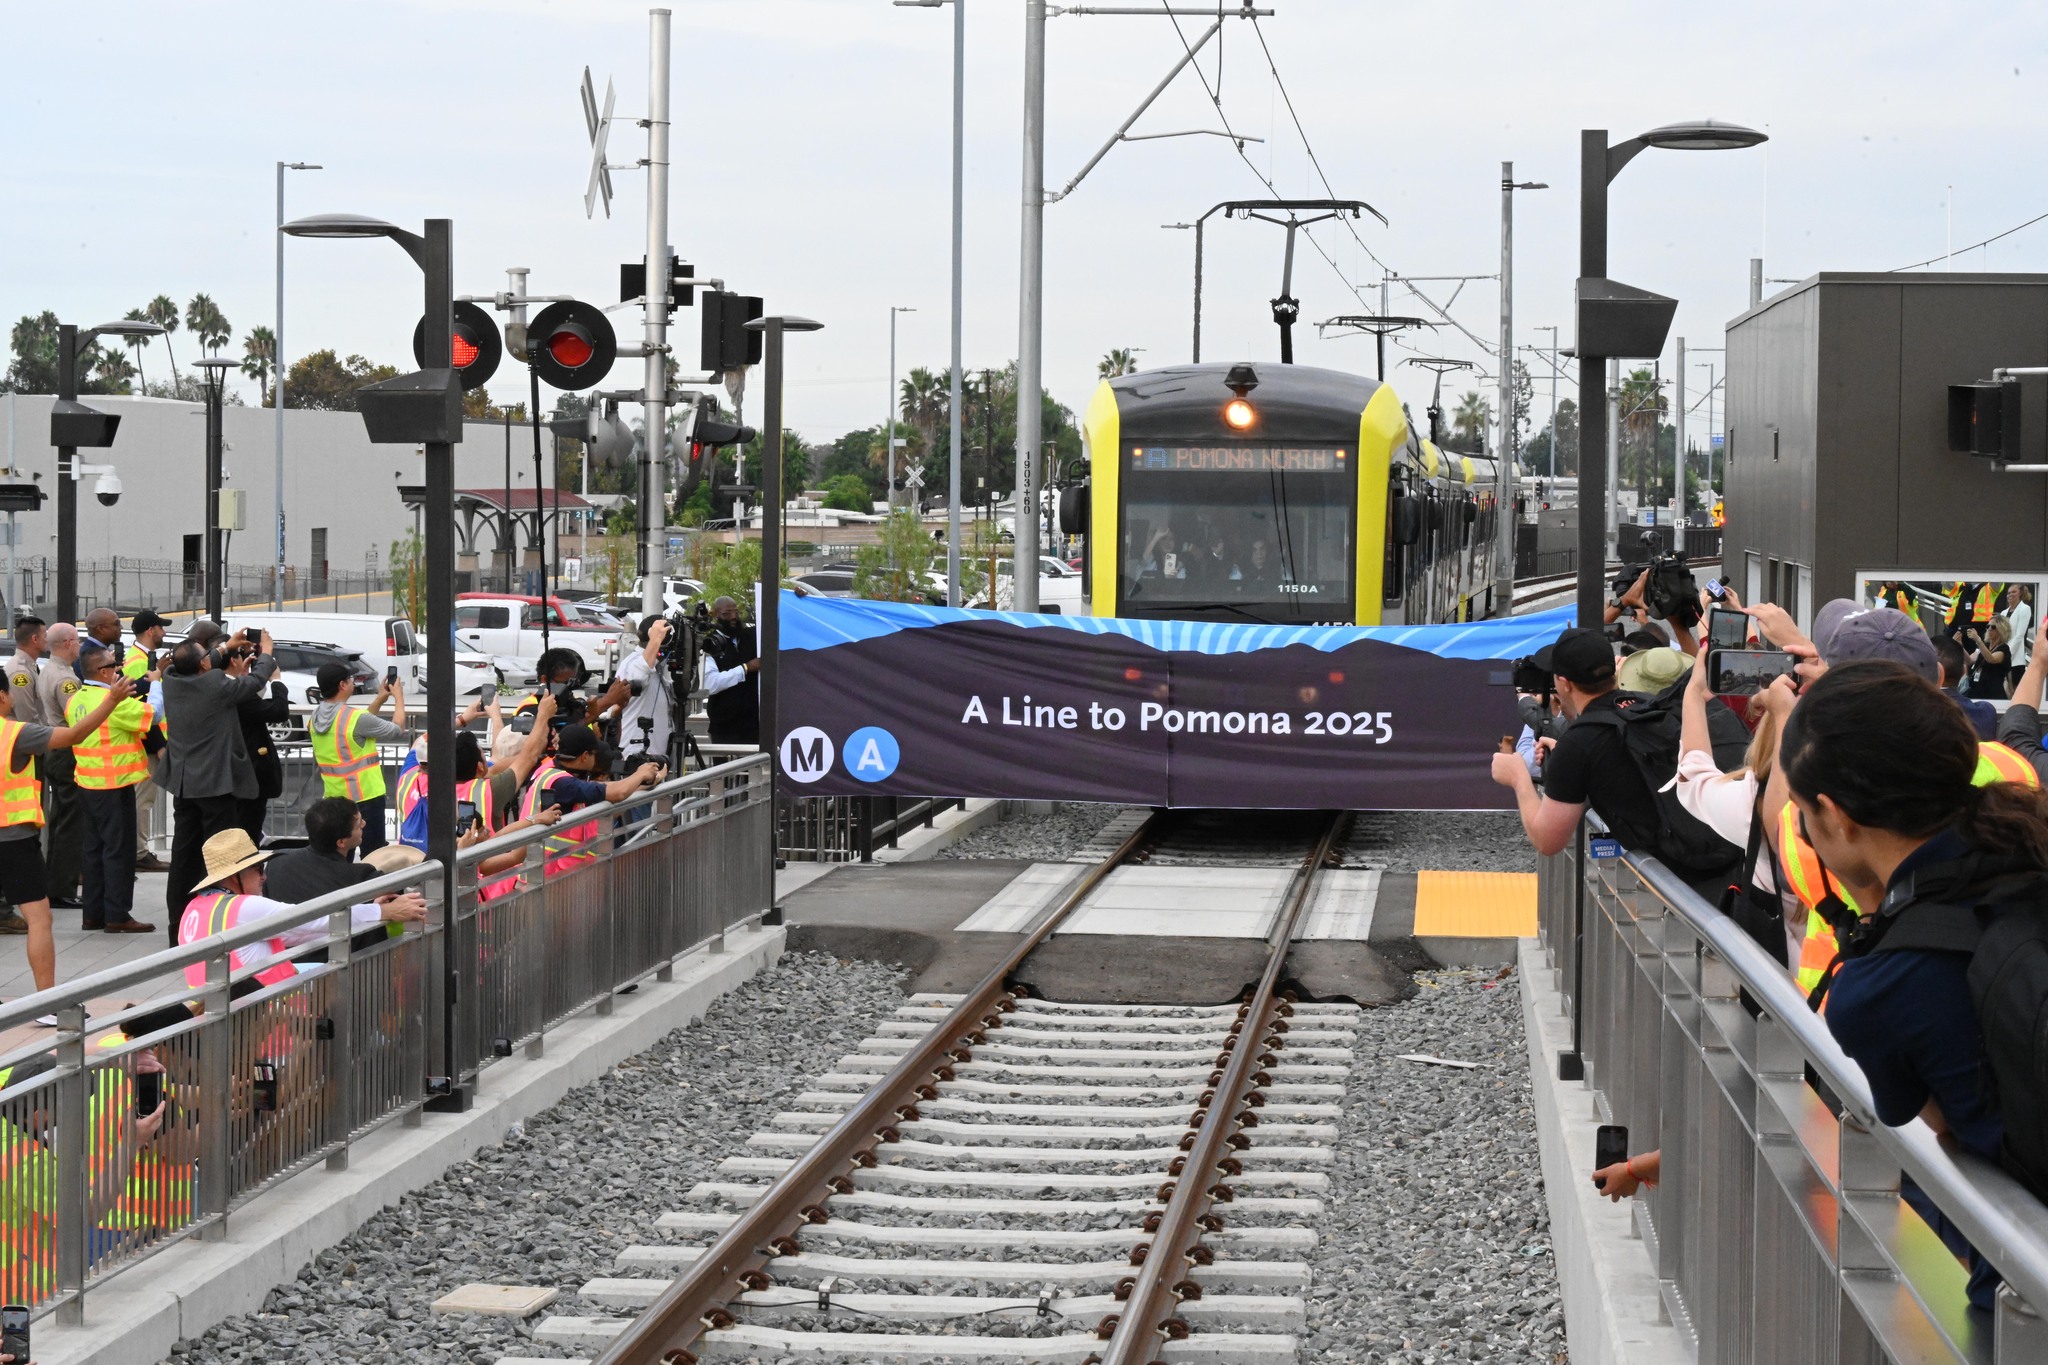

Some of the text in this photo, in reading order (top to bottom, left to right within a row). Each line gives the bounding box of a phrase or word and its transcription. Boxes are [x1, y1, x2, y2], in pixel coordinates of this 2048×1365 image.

[1147, 447, 1326, 470] A POMONA NORTH
[1023, 451, 1031, 515] 1903+60
[1676, 520, 1683, 528] H
[1277, 584, 1318, 593] 1150A
[961, 695, 1393, 744] A Line to Pomona 2025
[790, 737, 824, 772] M
[856, 738, 886, 771] A
[185, 914, 198, 938] M
